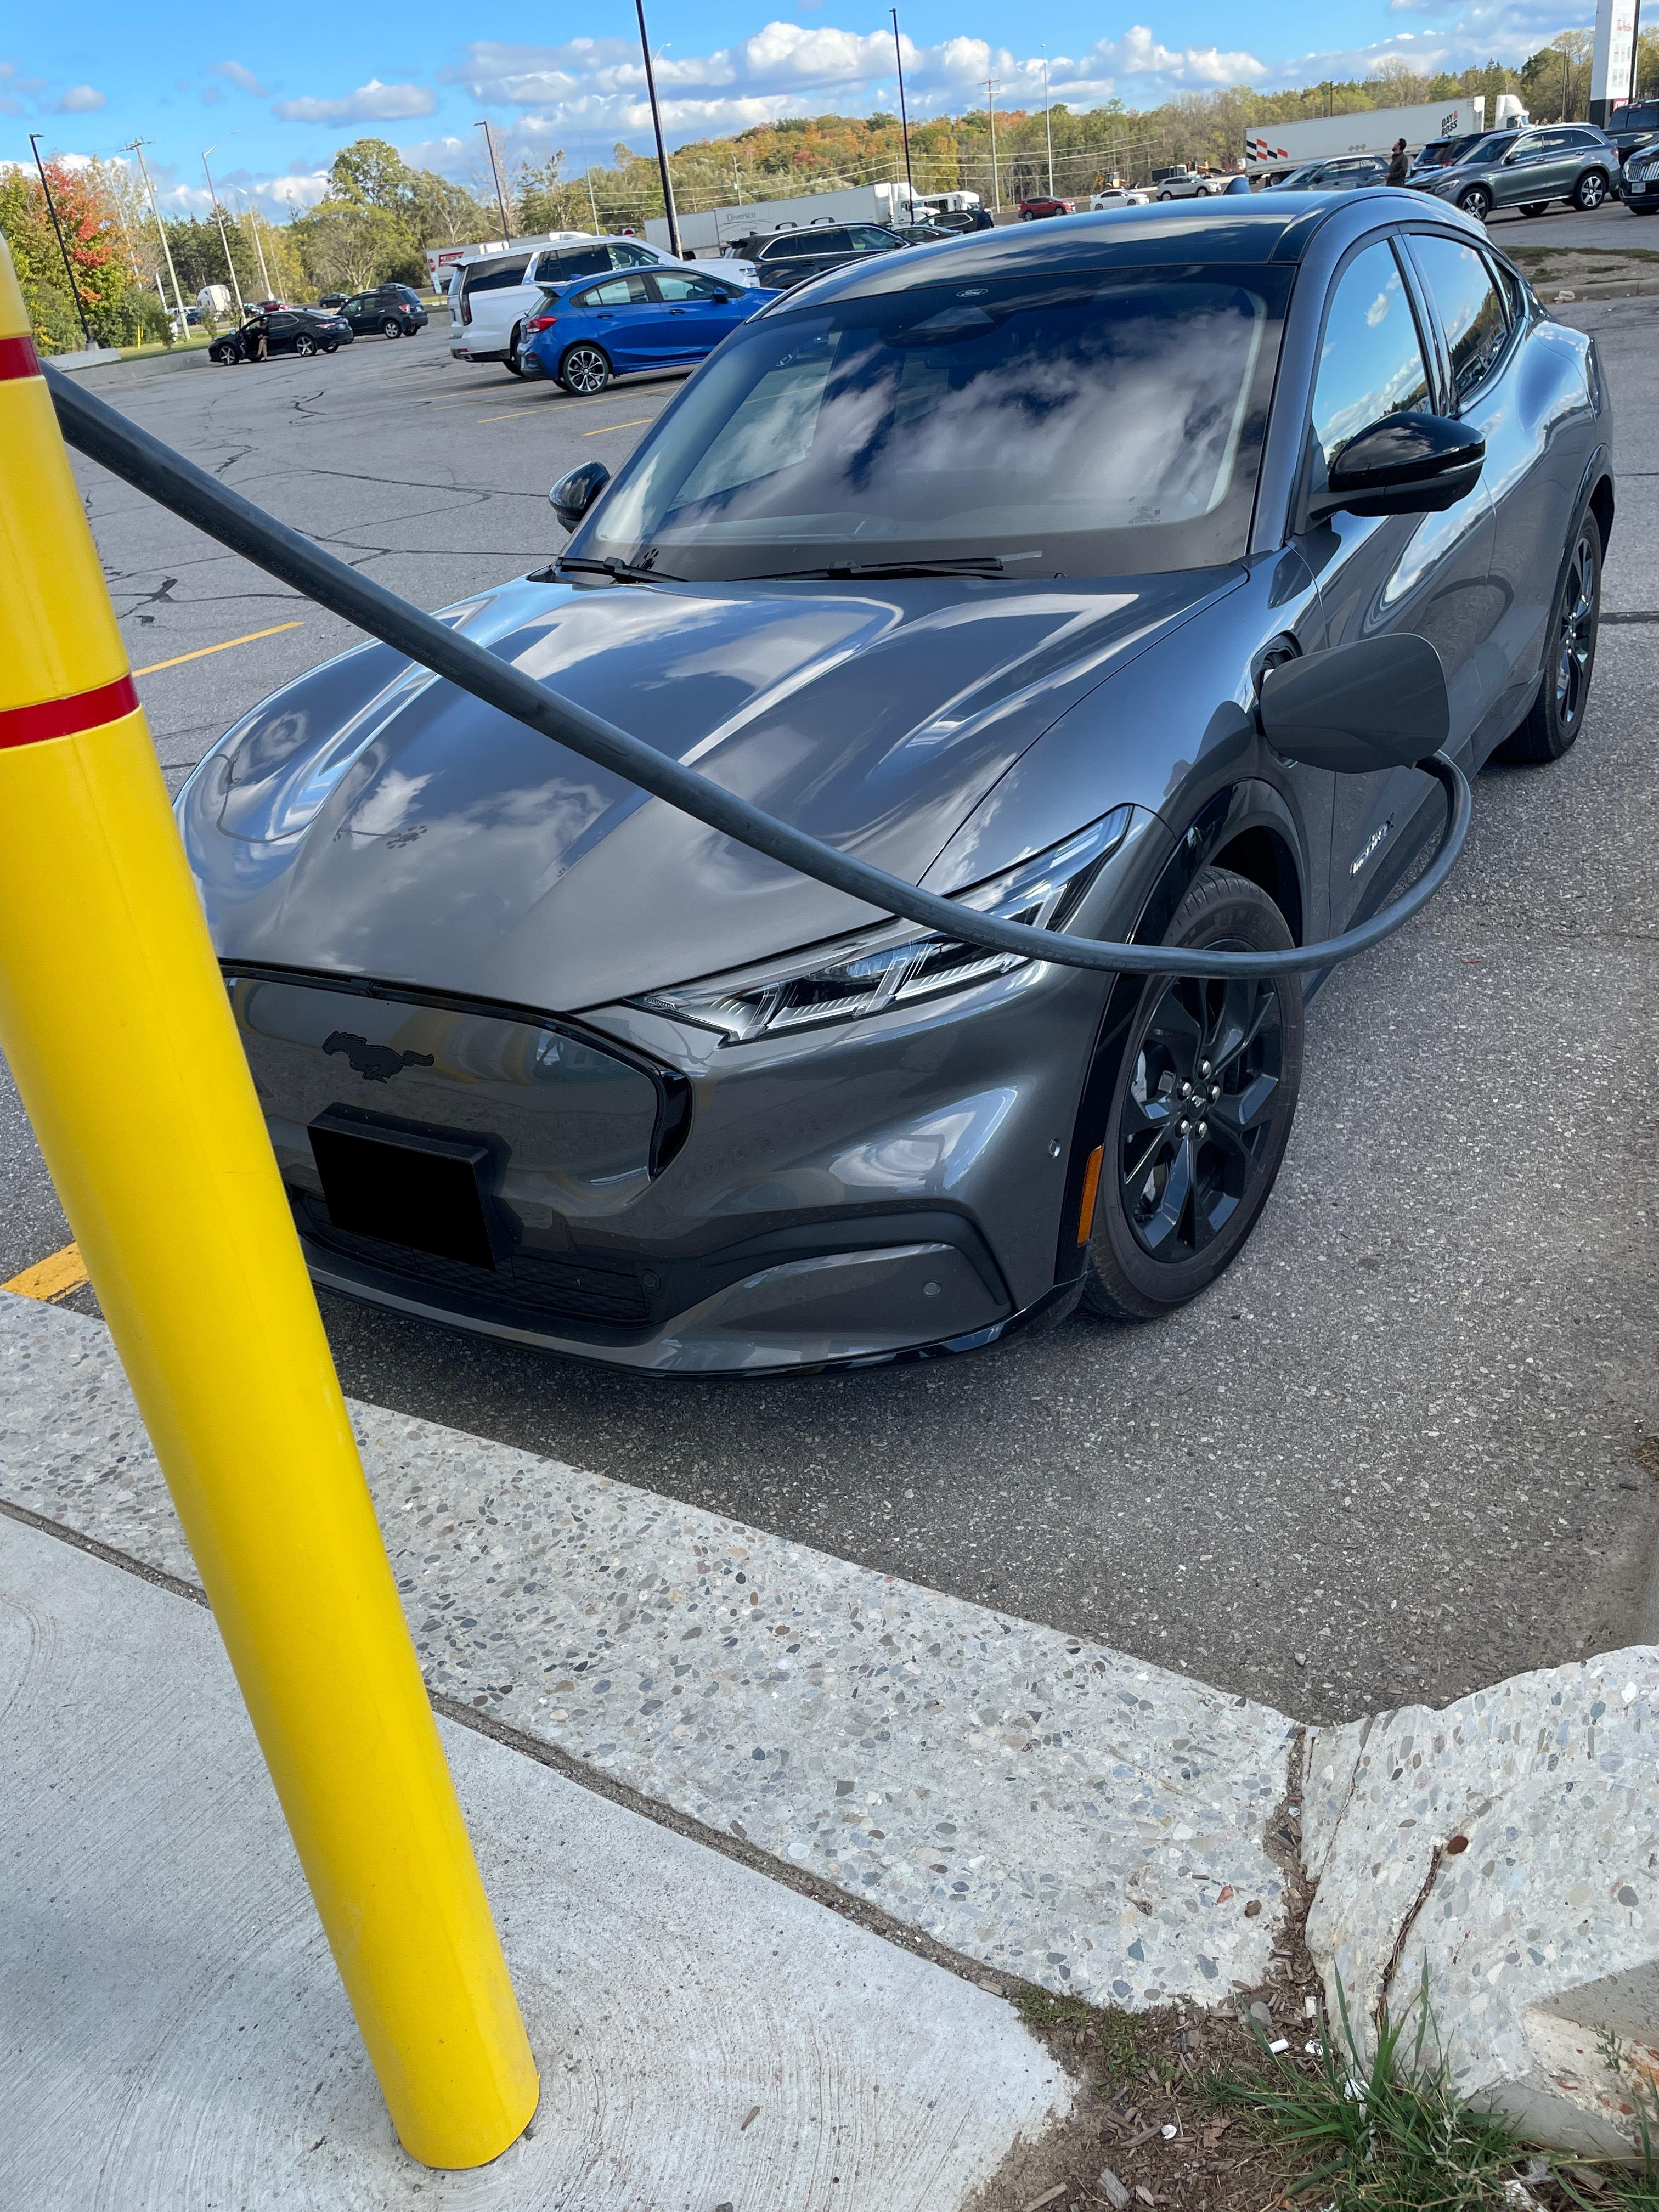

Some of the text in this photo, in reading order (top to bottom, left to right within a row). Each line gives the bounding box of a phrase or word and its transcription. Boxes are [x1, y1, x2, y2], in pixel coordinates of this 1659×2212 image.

[1442, 110, 1458, 128] DAY &
[1442, 120, 1457, 137] ROSS
[208, 521, 230, 539] USE
[232, 535, 253, 555] FOR
